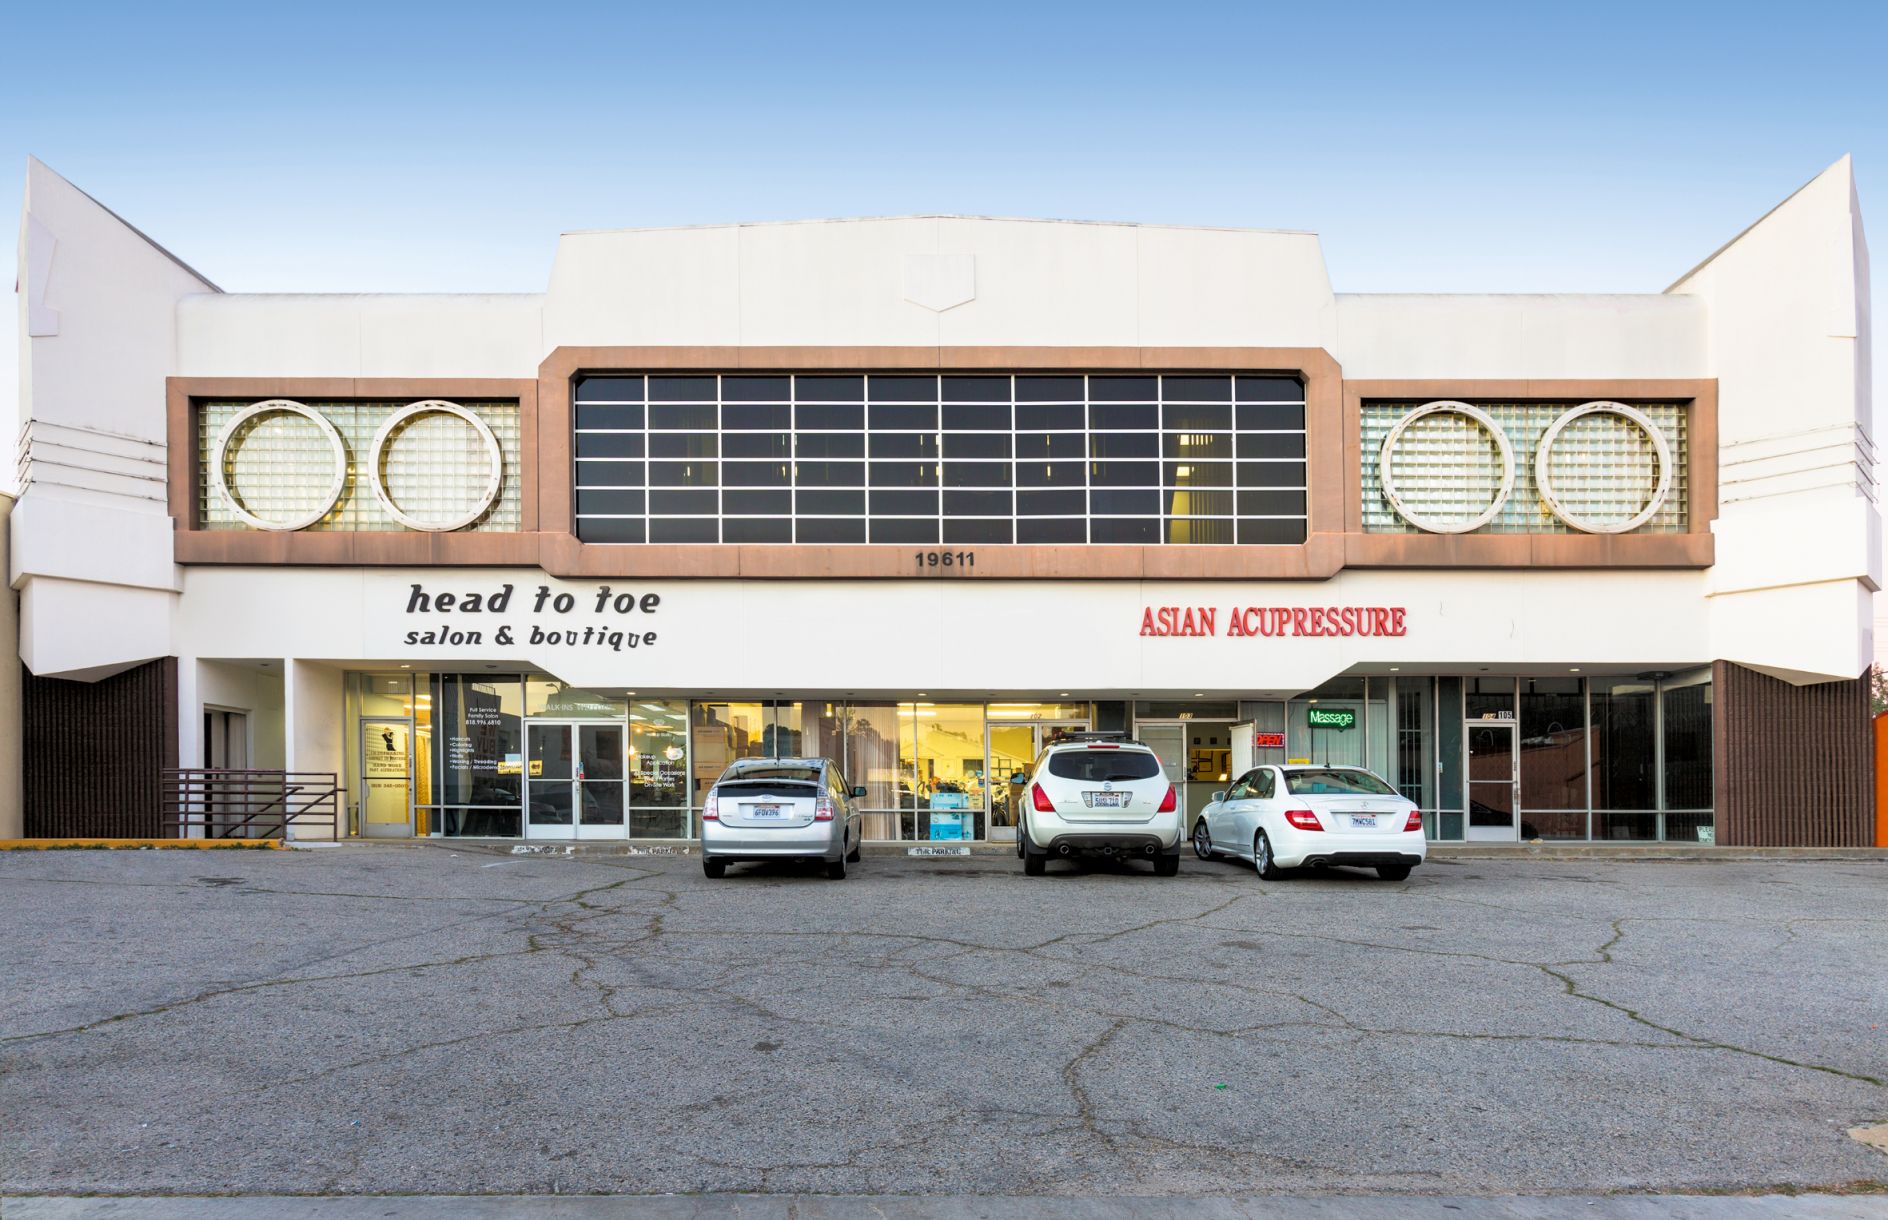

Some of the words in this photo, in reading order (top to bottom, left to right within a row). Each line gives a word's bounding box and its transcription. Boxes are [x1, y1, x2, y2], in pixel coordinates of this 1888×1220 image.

[915, 551, 975, 567] 19611
[406, 584, 514, 613] head
[533, 585, 575, 613] to
[594, 585, 661, 613] toe
[1139, 606, 1217, 637] ASIAN
[1227, 606, 1407, 637] ACUPRESSURE
[404, 625, 482, 645] salon
[494, 625, 515, 645] &
[529, 625, 657, 651] boutique
[1310, 711, 1353, 726] Massage
[1499, 711, 1512, 719] 105
[1257, 734, 1281, 745] OPEN
